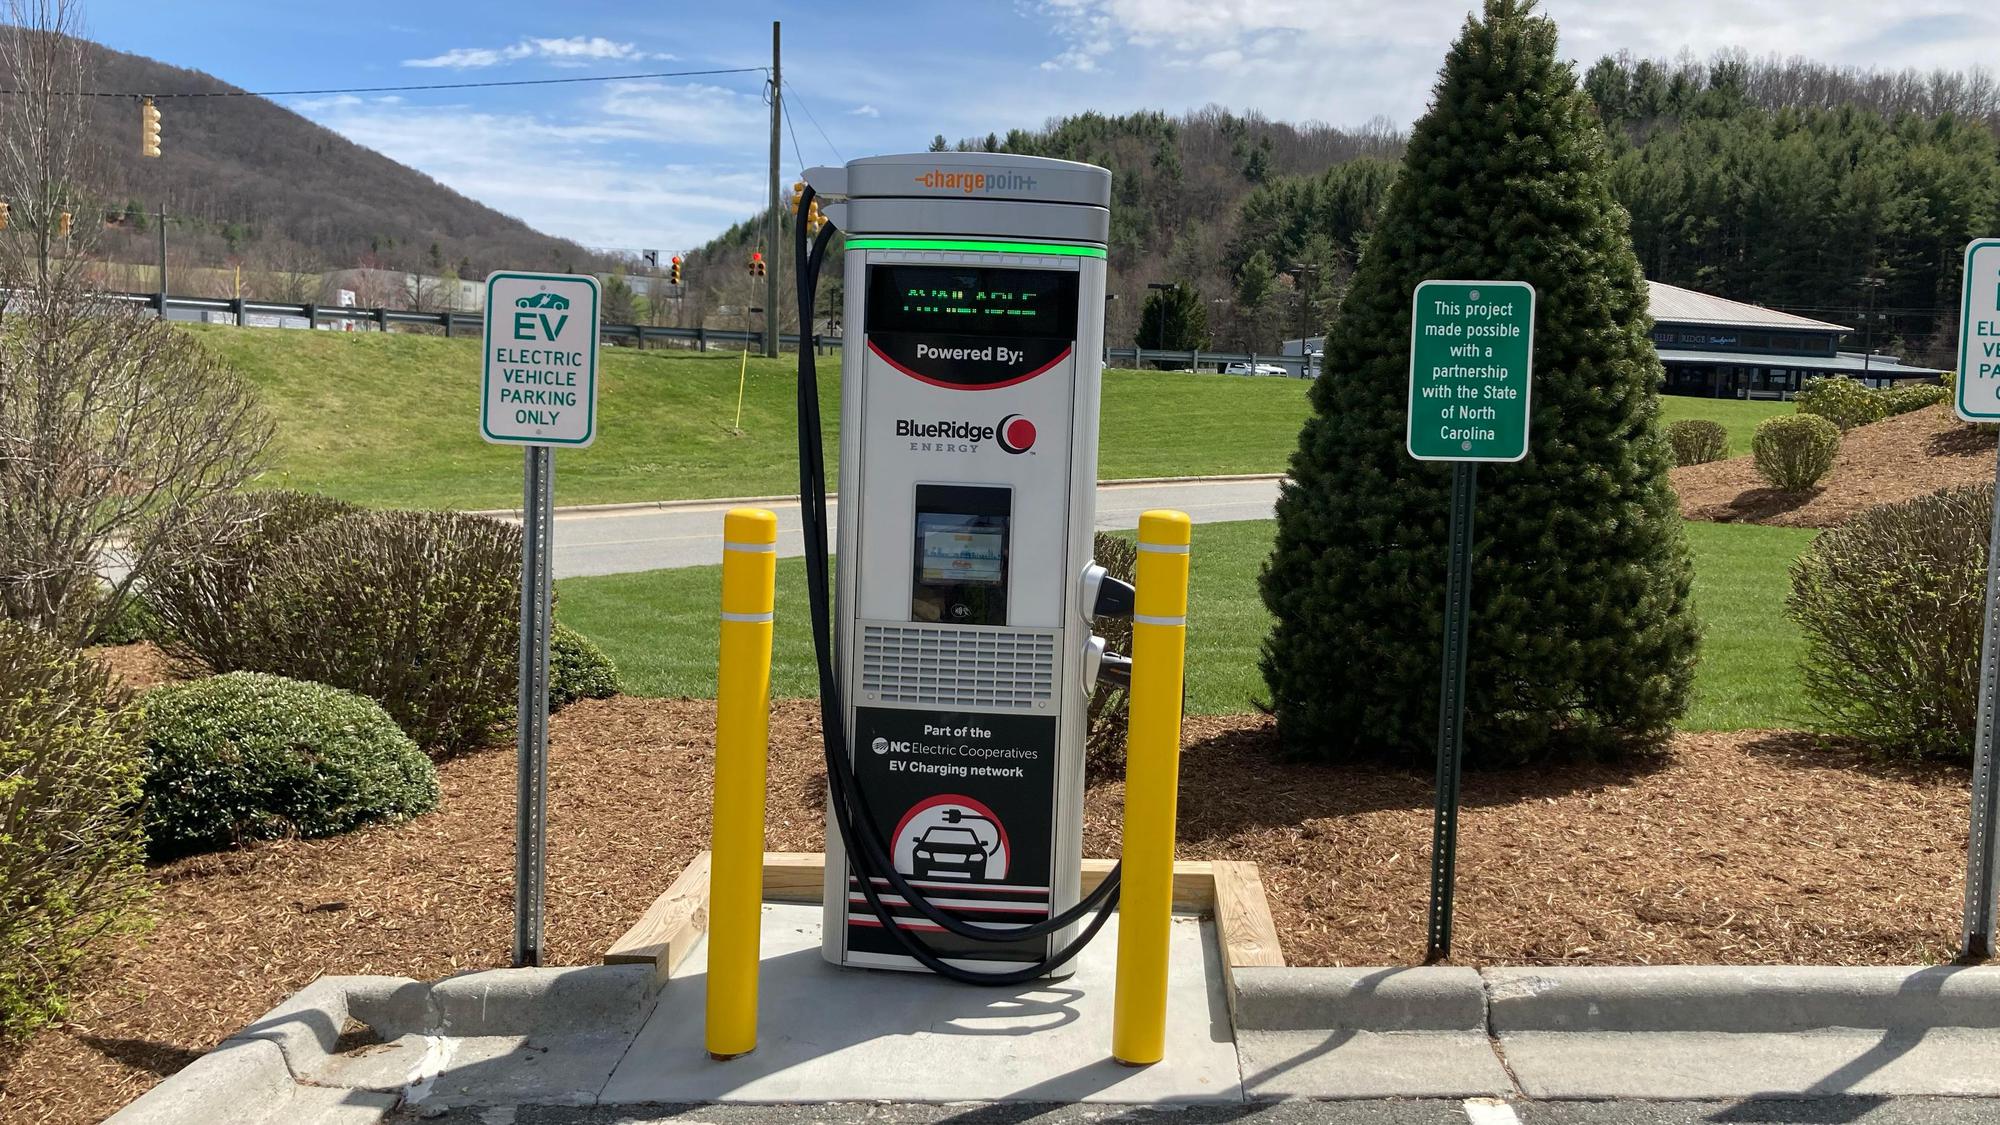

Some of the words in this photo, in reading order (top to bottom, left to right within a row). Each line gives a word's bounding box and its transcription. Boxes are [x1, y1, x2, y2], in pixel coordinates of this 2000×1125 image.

[1434, 301, 1460, 316] This
[1465, 302, 1513, 320] project
[514, 312, 569, 342] EV
[1425, 322, 1462, 336] made
[1466, 323, 1520, 339] possible
[497, 348, 582, 367] ELECTRIC
[916, 344, 992, 361] Powered
[996, 346, 1024, 365] By:
[1450, 344, 1480, 357] with
[1485, 346, 1493, 357] a
[503, 369, 577, 386] VEHICLE
[1432, 364, 1508, 381] partnership
[501, 389, 577, 407] PARKING
[1422, 385, 1451, 398] with
[1457, 385, 1478, 399] the
[1483, 385, 1517, 400] State
[515, 409, 560, 426] ONLY
[1441, 405, 1455, 419] of
[1459, 405, 1496, 419] North
[896, 419, 994, 442] BlueRidge
[1440, 426, 1495, 440] Carolina
[910, 442, 979, 453] ENERGY
[924, 724, 951, 737] Part
[954, 726, 968, 737] of
[970, 727, 992, 738] the
[890, 741, 911, 753] NC
[912, 742, 957, 755] Electric
[959, 744, 1038, 760] Cooperatives
[889, 760, 907, 772] EV
[909, 761, 968, 777] Charging
[970, 766, 1024, 777] network
